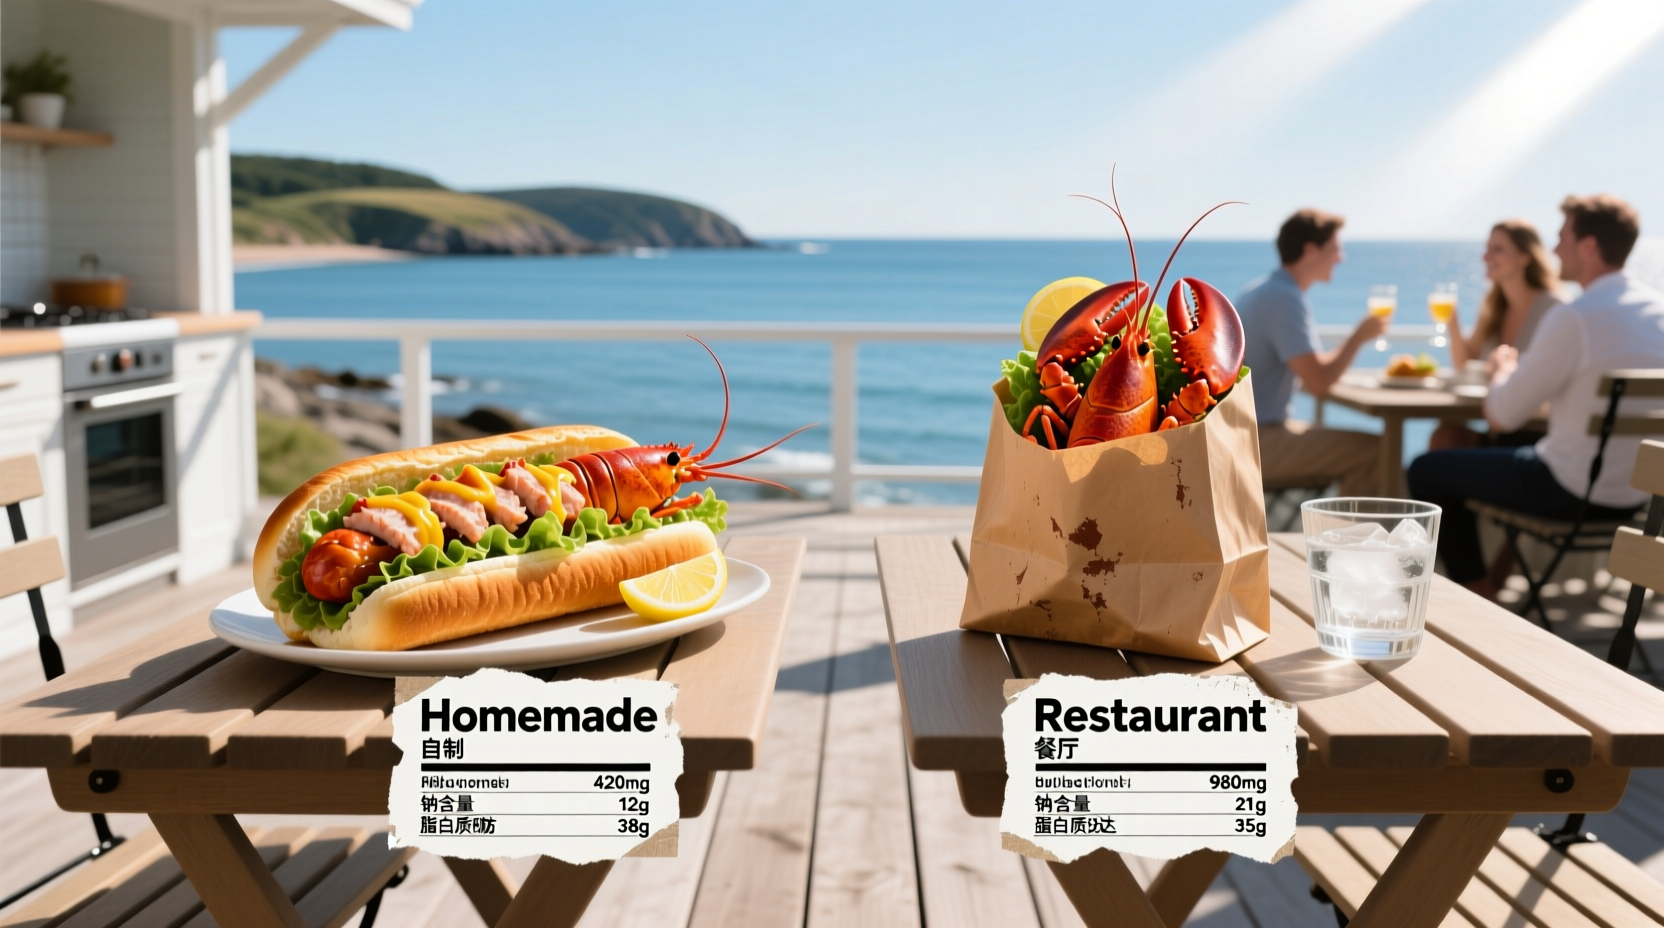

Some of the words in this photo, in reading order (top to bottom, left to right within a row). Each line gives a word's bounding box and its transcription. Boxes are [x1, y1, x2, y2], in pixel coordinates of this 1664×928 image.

[421, 697, 658, 732] Homemade
[1035, 698, 1267, 732] Restaurant
[422, 737, 464, 760] 自制
[1034, 736, 1079, 760] 餐厅
[593, 775, 650, 794] 420mg
[1209, 774, 1267, 793] 980mg
[618, 796, 650, 815] 12g
[1235, 797, 1267, 816] 21g
[617, 818, 650, 838] 38g
[1235, 818, 1267, 837] 35g
